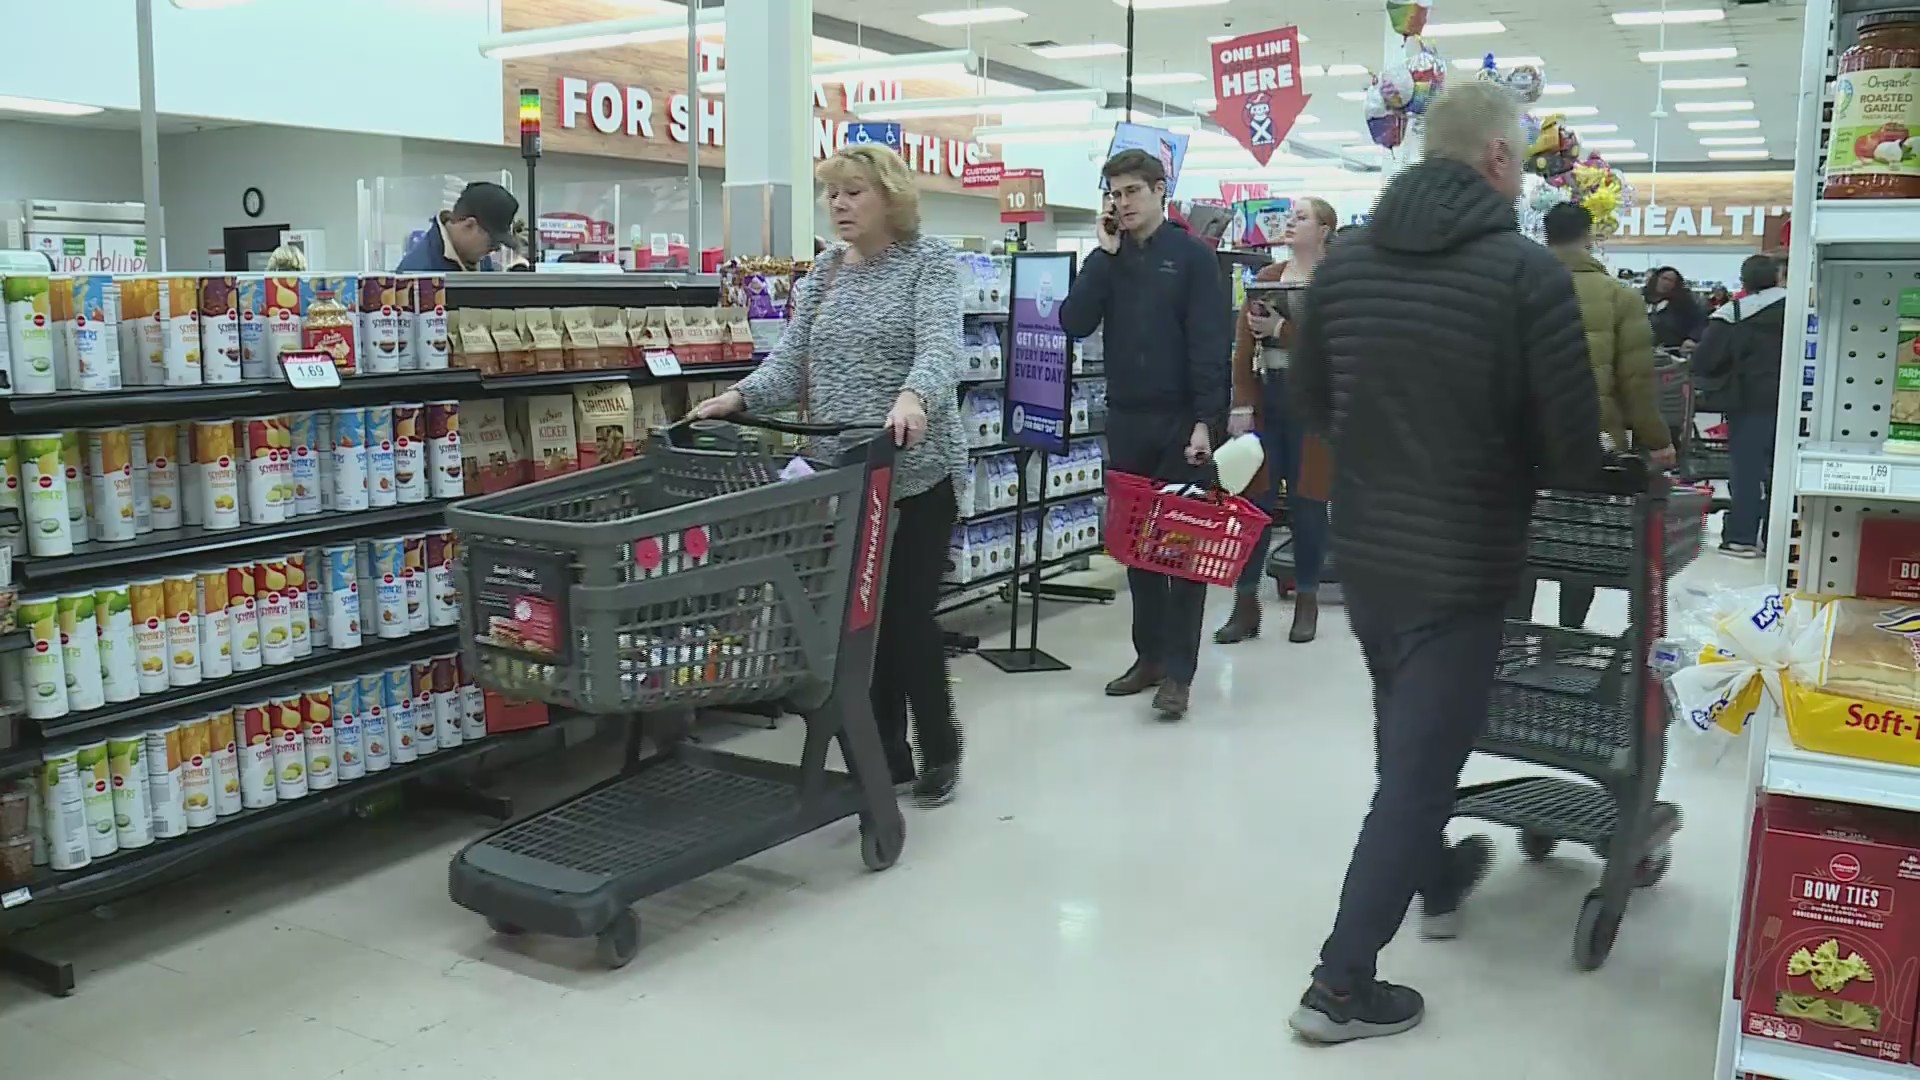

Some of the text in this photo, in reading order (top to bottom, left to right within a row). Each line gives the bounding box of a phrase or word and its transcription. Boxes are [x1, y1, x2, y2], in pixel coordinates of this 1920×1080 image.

[1220, 38, 1291, 64] ONE LINE
[1221, 63, 1293, 98] HERE
[1867, 73, 1910, 92] Organic
[558, 75, 655, 138] FOR
[1860, 93, 1913, 105] ROASTED
[1863, 103, 1907, 114] GARLIC
[1007, 192, 1025, 208] 10
[1033, 191, 1044, 208] 10
[1016, 332, 1067, 350] GET 15% OFF
[1015, 348, 1064, 365] EVERY BOTTLE
[297, 365, 324, 377] 1.69
[1015, 362, 1043, 380] EVERY
[583, 397, 629, 414] ORIGINAL
[538, 425, 567, 438] KICKER
[1803, 880, 1880, 908] BOW TIES
[1855, 919, 1884, 929] PRODUCT
